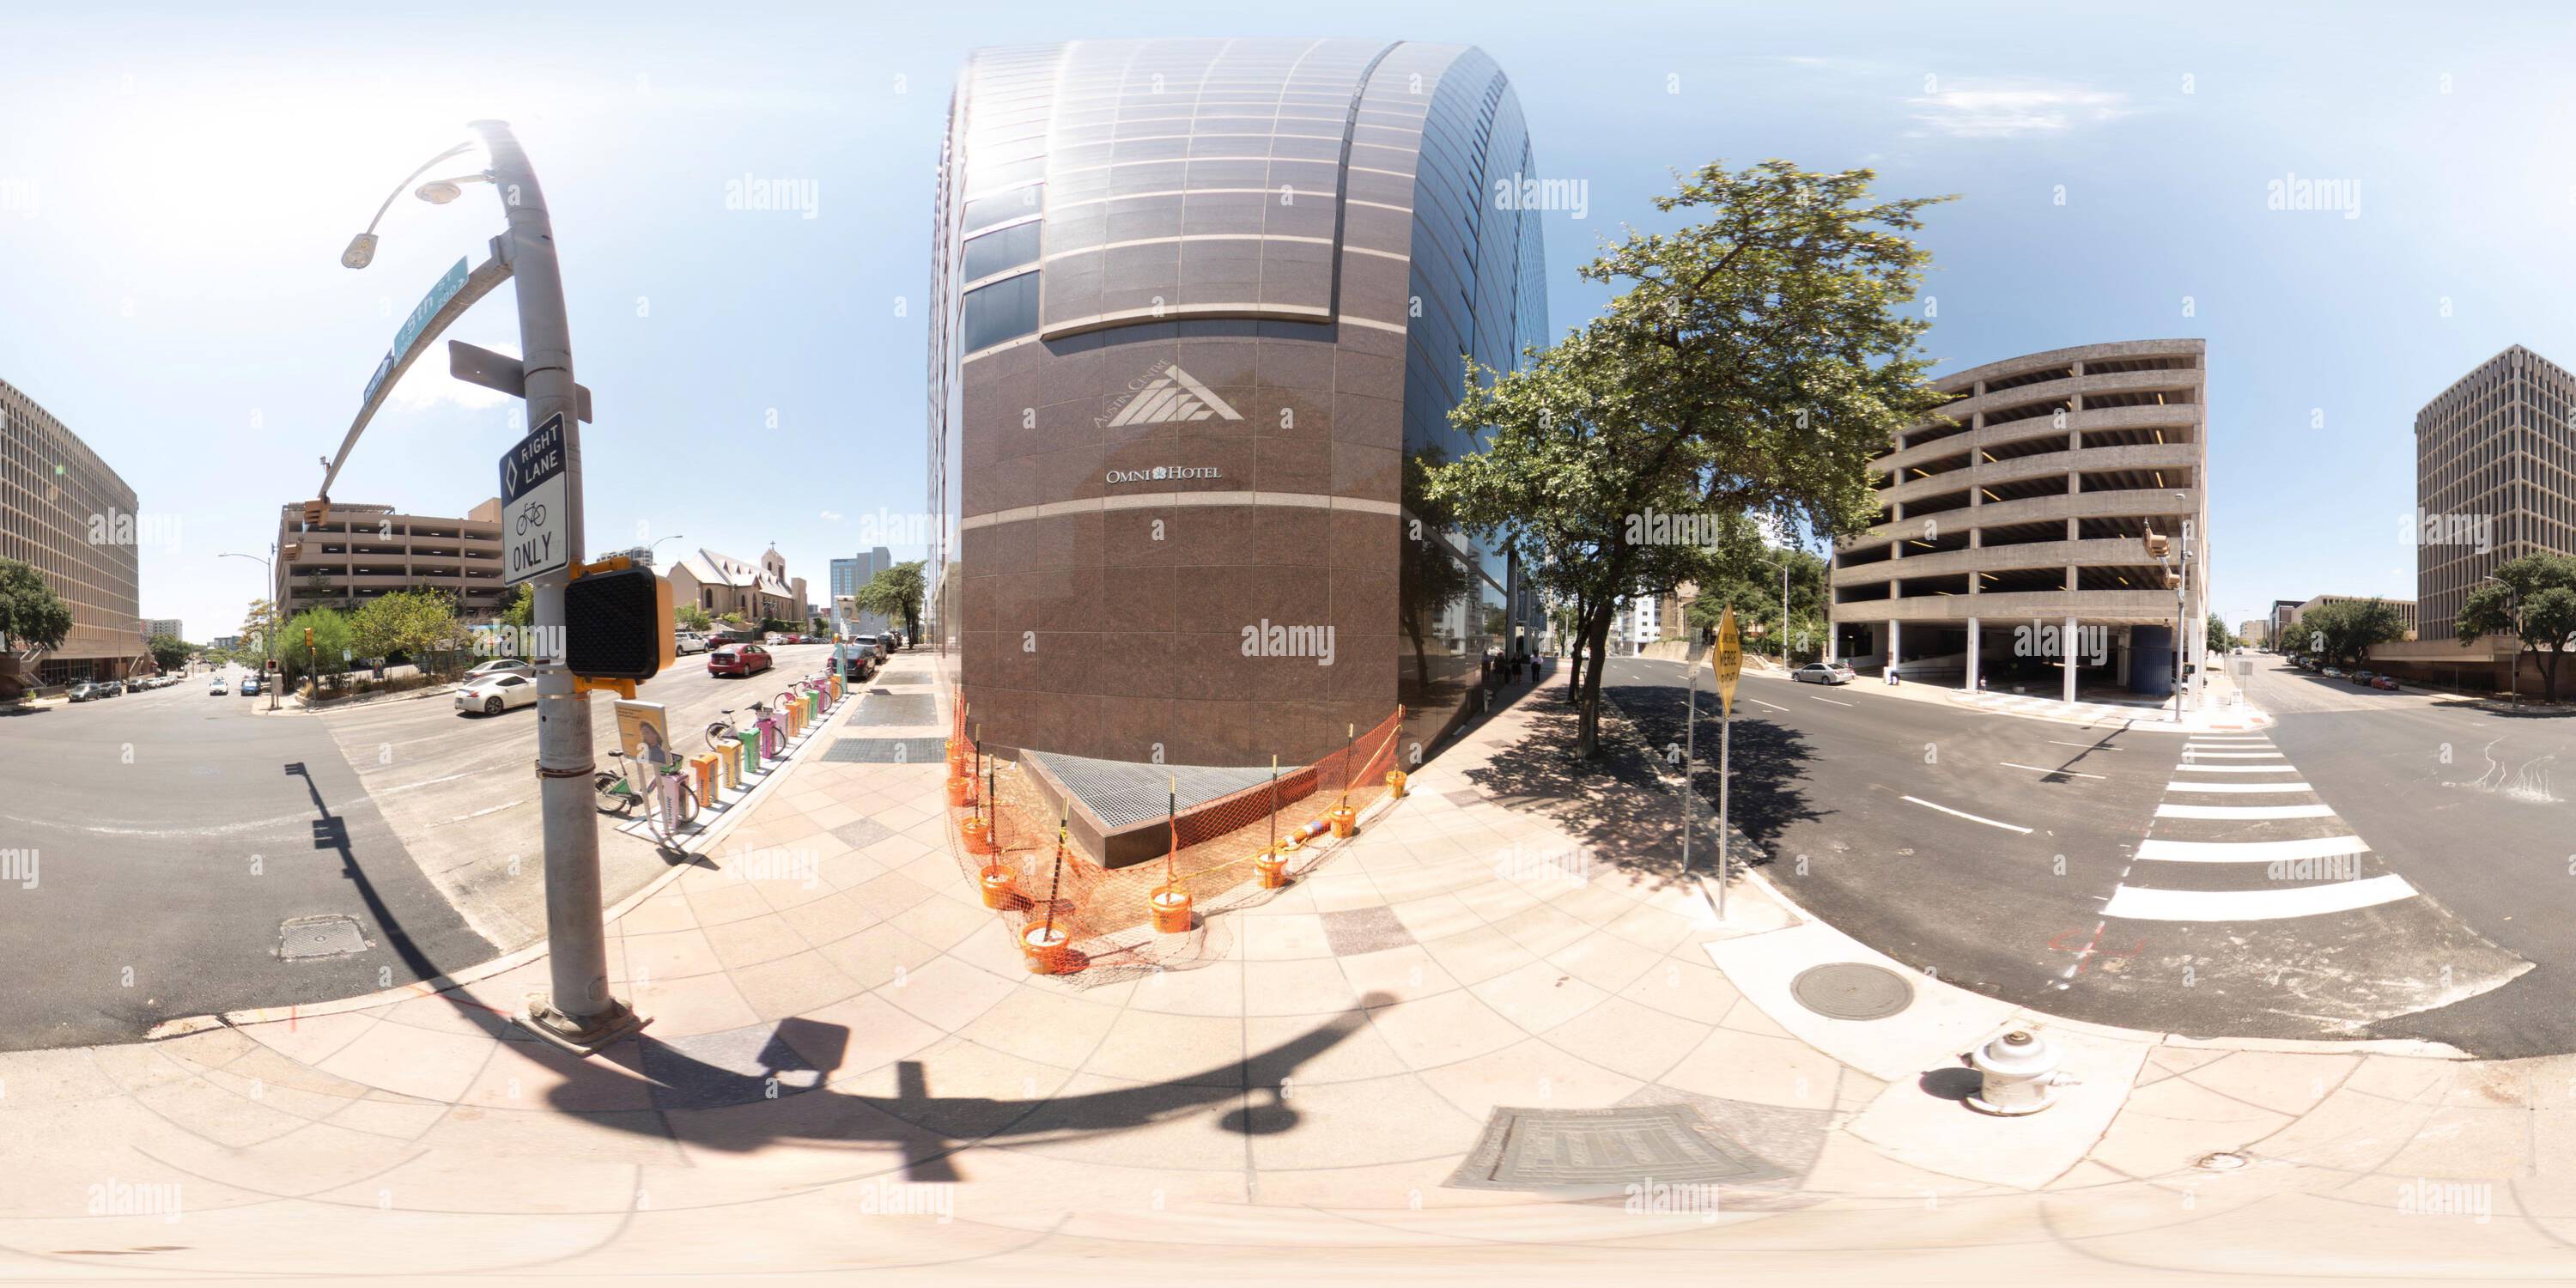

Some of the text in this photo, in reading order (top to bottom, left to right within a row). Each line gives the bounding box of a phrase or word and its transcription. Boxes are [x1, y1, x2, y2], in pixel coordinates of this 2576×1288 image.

[1093, 358, 1171, 428] AUSTIN CENTRE
[521, 424, 558, 464] RIGHT
[525, 449, 558, 483] LANE
[1106, 465, 1223, 483] OMNI HOTEL
[513, 531, 552, 572] ONLY
